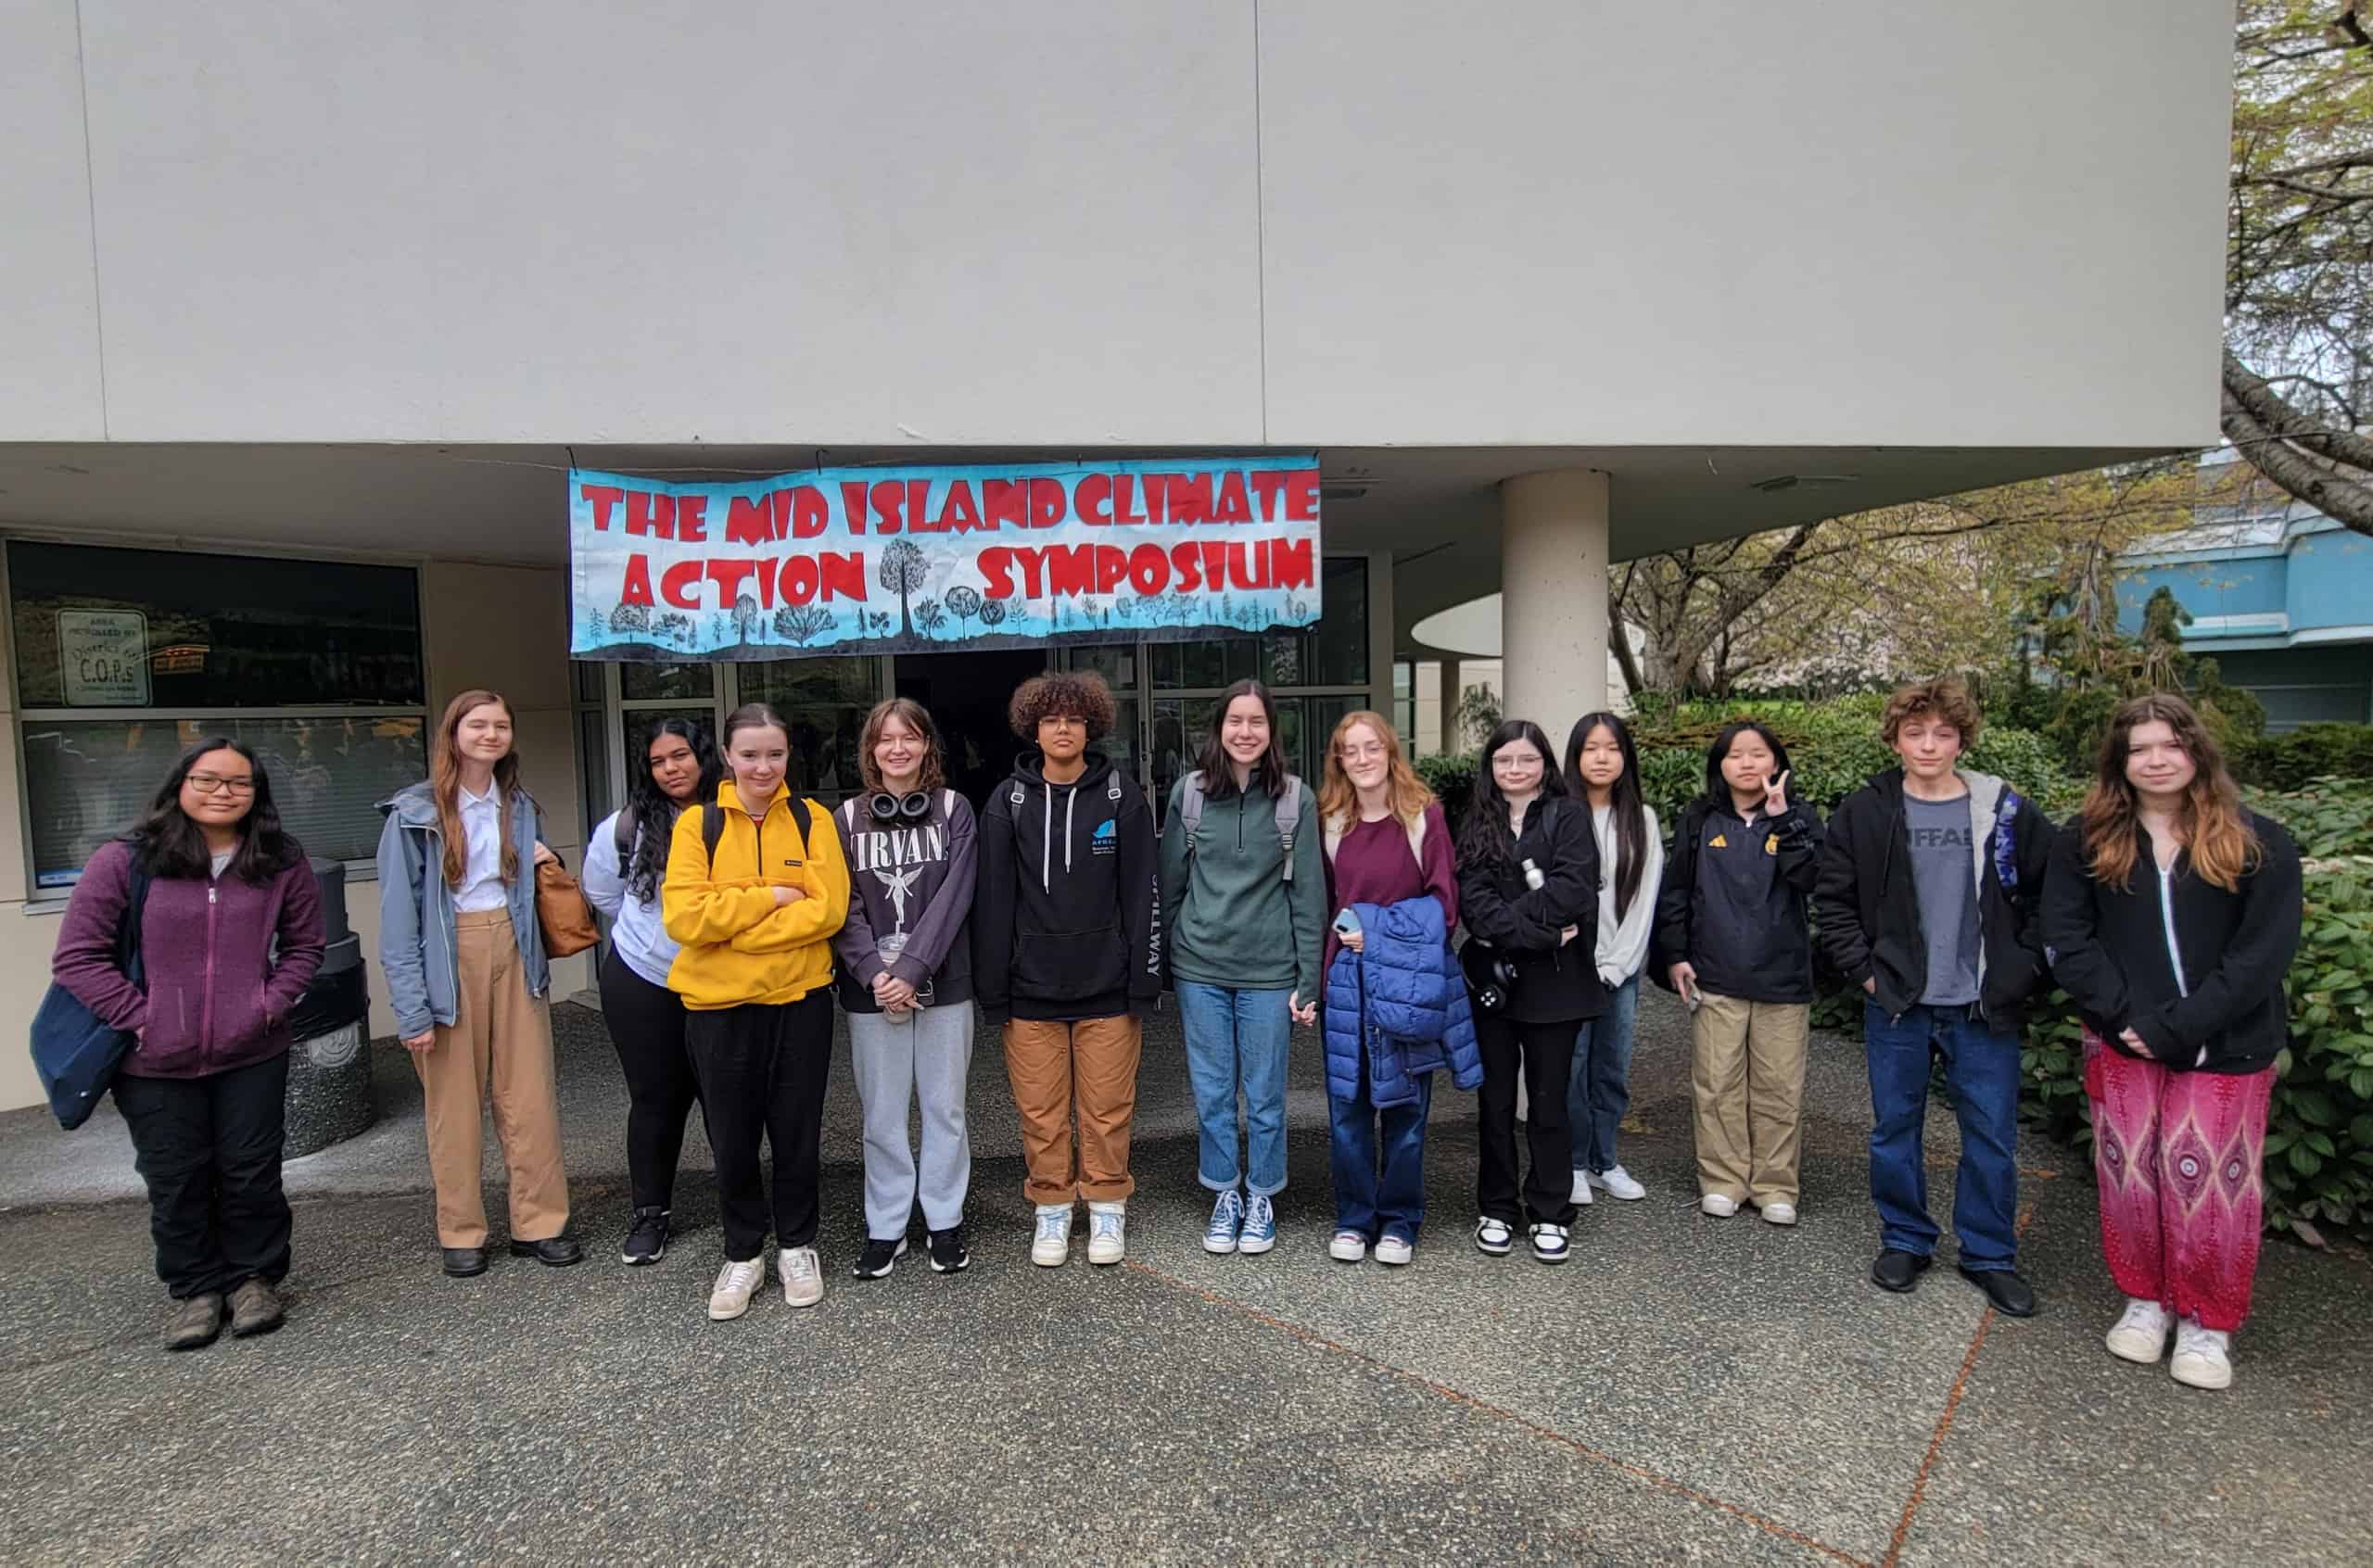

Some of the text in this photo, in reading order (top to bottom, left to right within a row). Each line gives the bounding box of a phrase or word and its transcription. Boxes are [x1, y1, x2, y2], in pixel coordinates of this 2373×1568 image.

[580, 469, 1321, 547] THE MID ISLAND CLIMATE
[621, 537, 1313, 611] ACTION SYMPOSIUM
[849, 823, 950, 872] IRVAN
